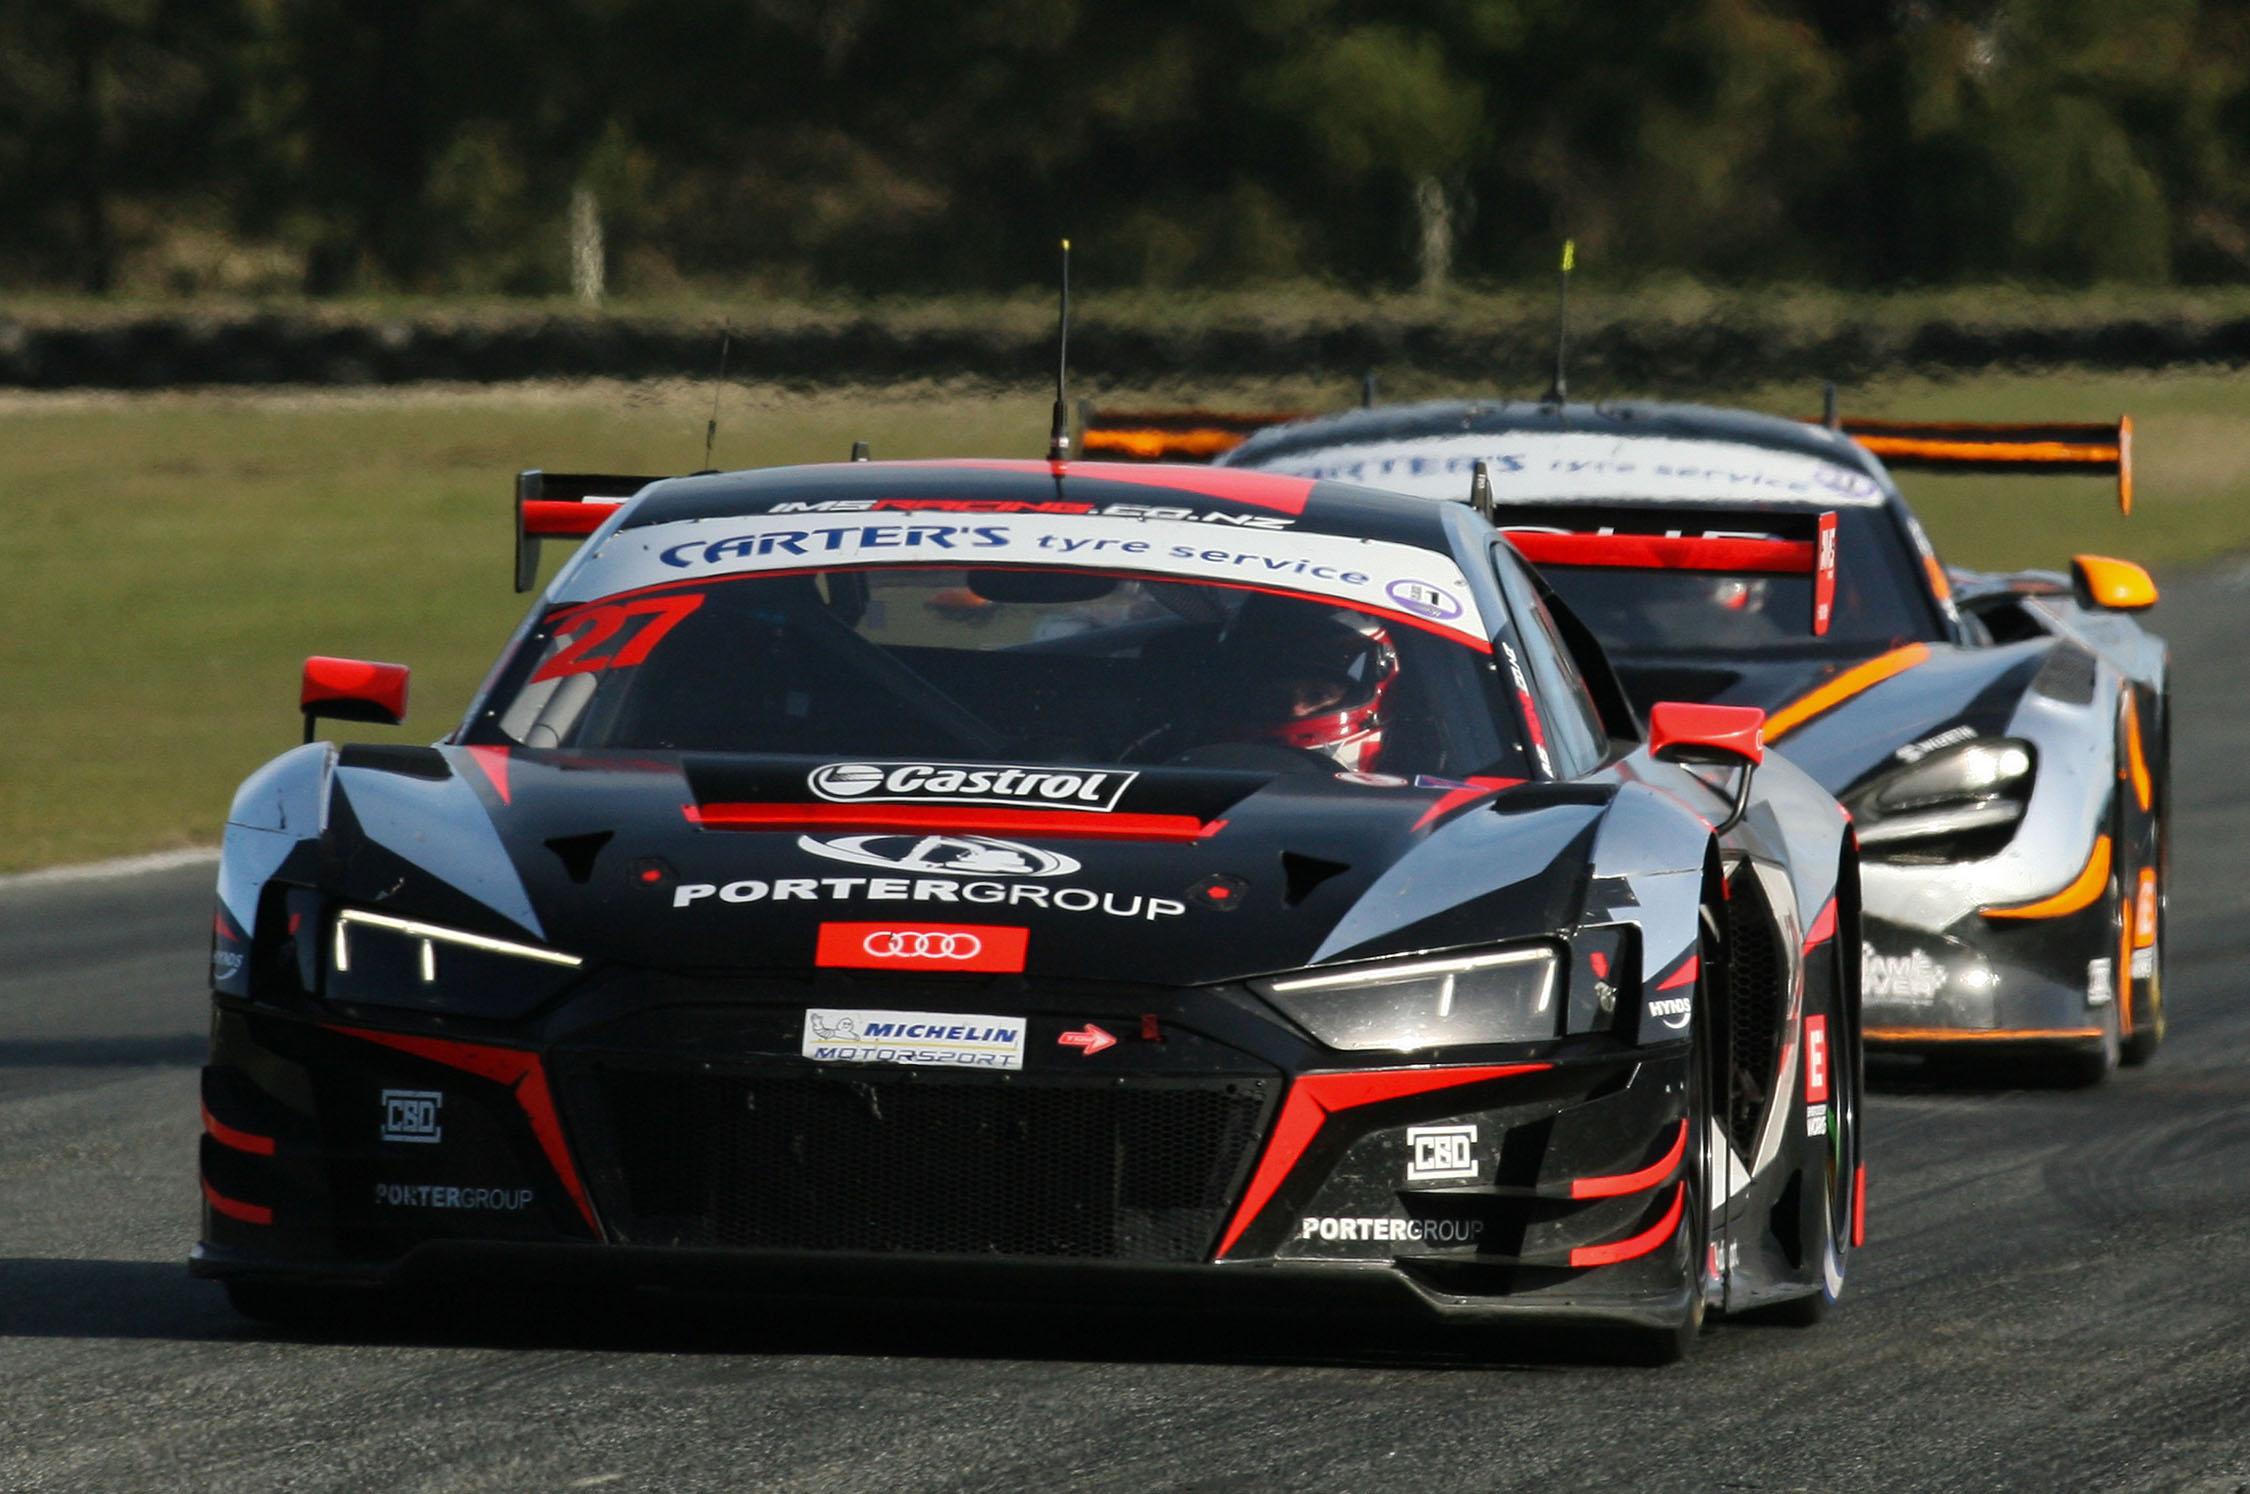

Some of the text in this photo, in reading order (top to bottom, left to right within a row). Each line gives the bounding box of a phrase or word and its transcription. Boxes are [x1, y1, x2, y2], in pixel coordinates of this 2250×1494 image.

[659, 525, 1370, 586] CARTER'S tyre service
[529, 593, 706, 685] 27
[883, 764, 1102, 801] Castrol
[672, 877, 1187, 921] PORTERGROUP
[1649, 997, 1692, 1018] HYNDS
[864, 1022, 1018, 1043] MICHELIN
[814, 1046, 1017, 1067] MOTORSPORT
[387, 1100, 436, 1133] CBD
[1414, 1134, 1471, 1171] CBD
[375, 1183, 535, 1210] PORTERGROUP
[1302, 1217, 1484, 1241] PORTERGROUP
